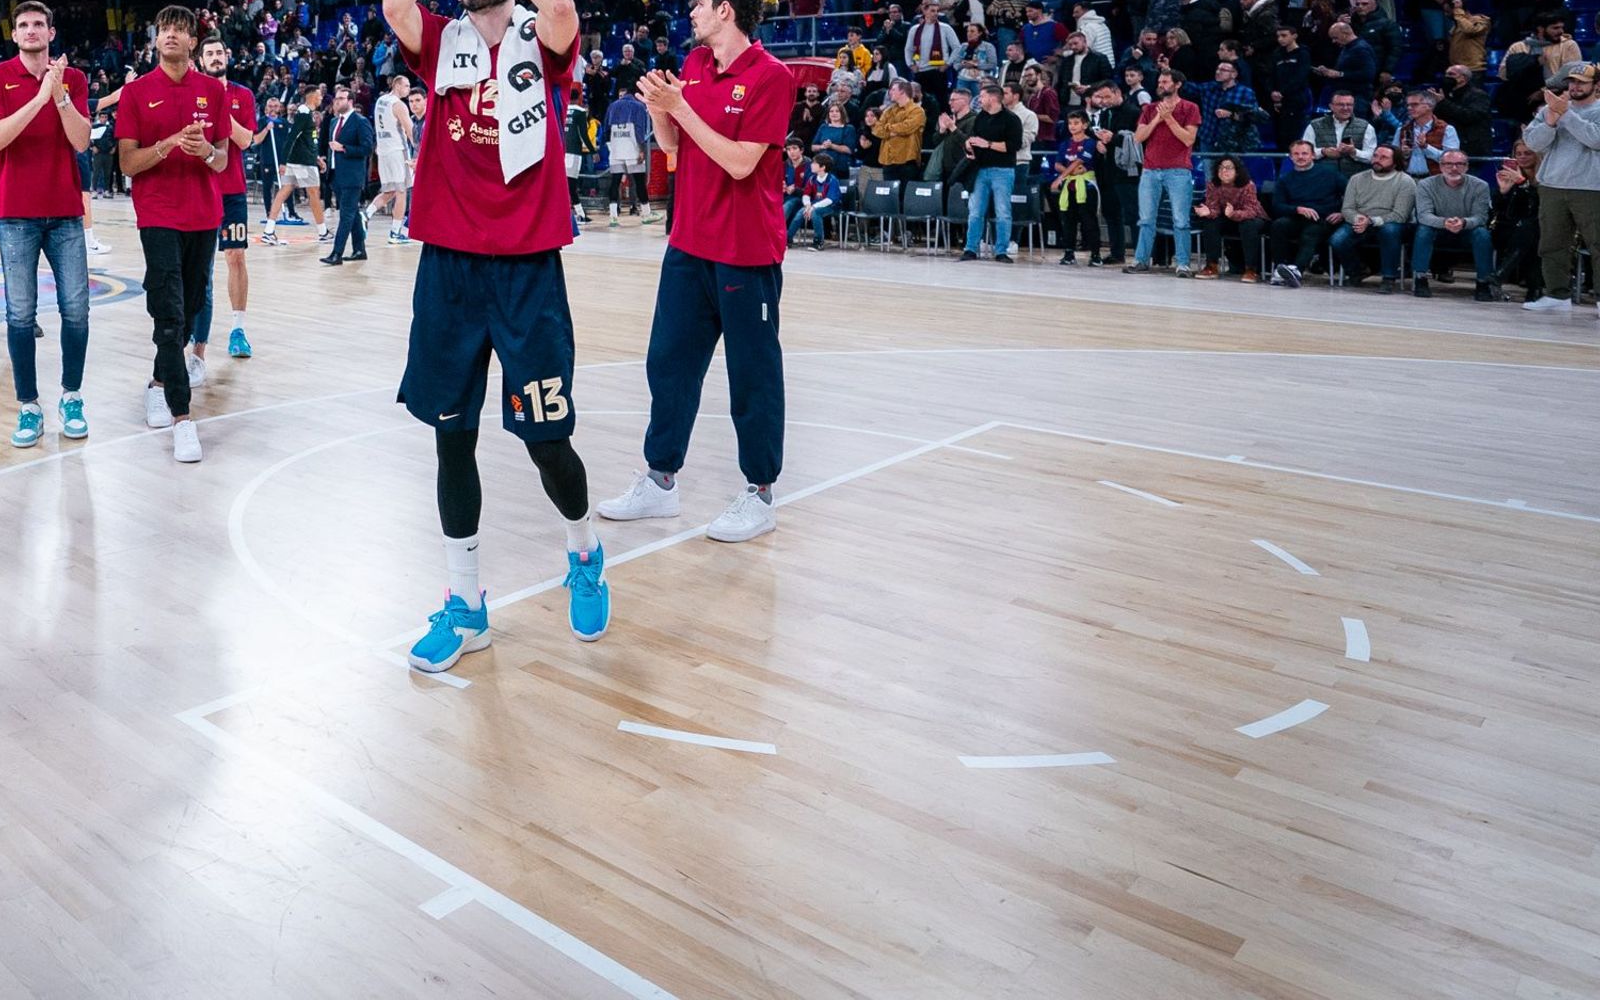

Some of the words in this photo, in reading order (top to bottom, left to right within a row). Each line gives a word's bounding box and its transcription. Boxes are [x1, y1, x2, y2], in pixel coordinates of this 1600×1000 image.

[469, 78, 499, 117] 13
[229, 223, 246, 242] 10
[523, 376, 569, 423] 13
